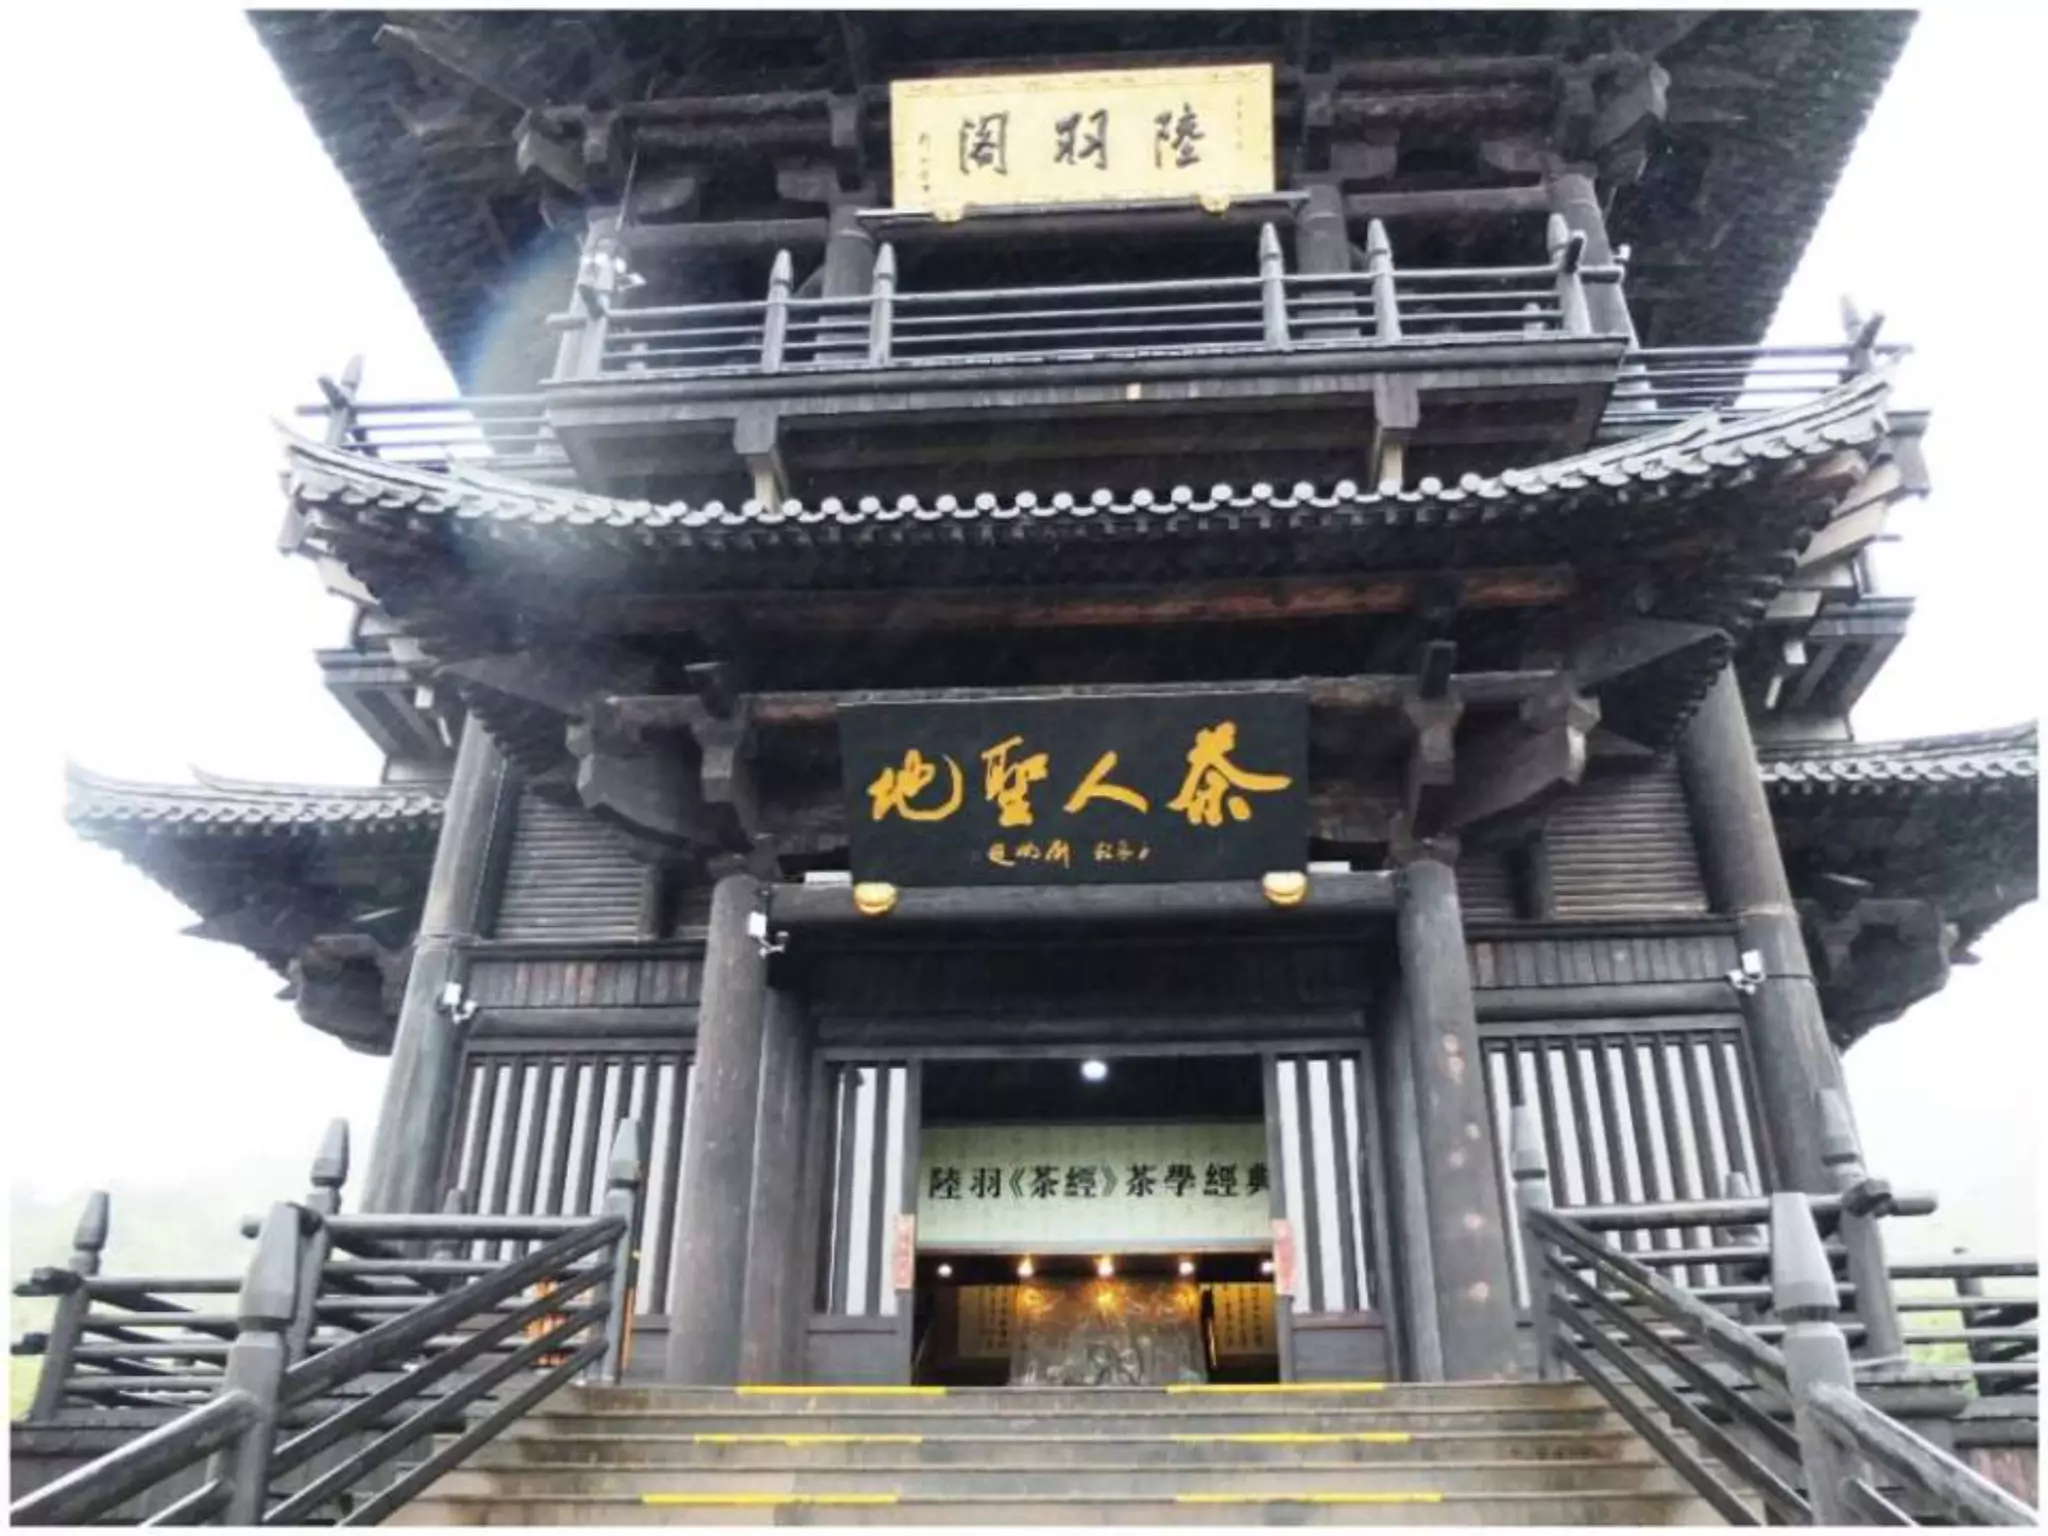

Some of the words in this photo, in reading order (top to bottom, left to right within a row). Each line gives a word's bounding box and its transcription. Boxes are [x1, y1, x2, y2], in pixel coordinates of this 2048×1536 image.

[929, 1162, 1269, 1199] 陸羽《茶經》茶學經典
